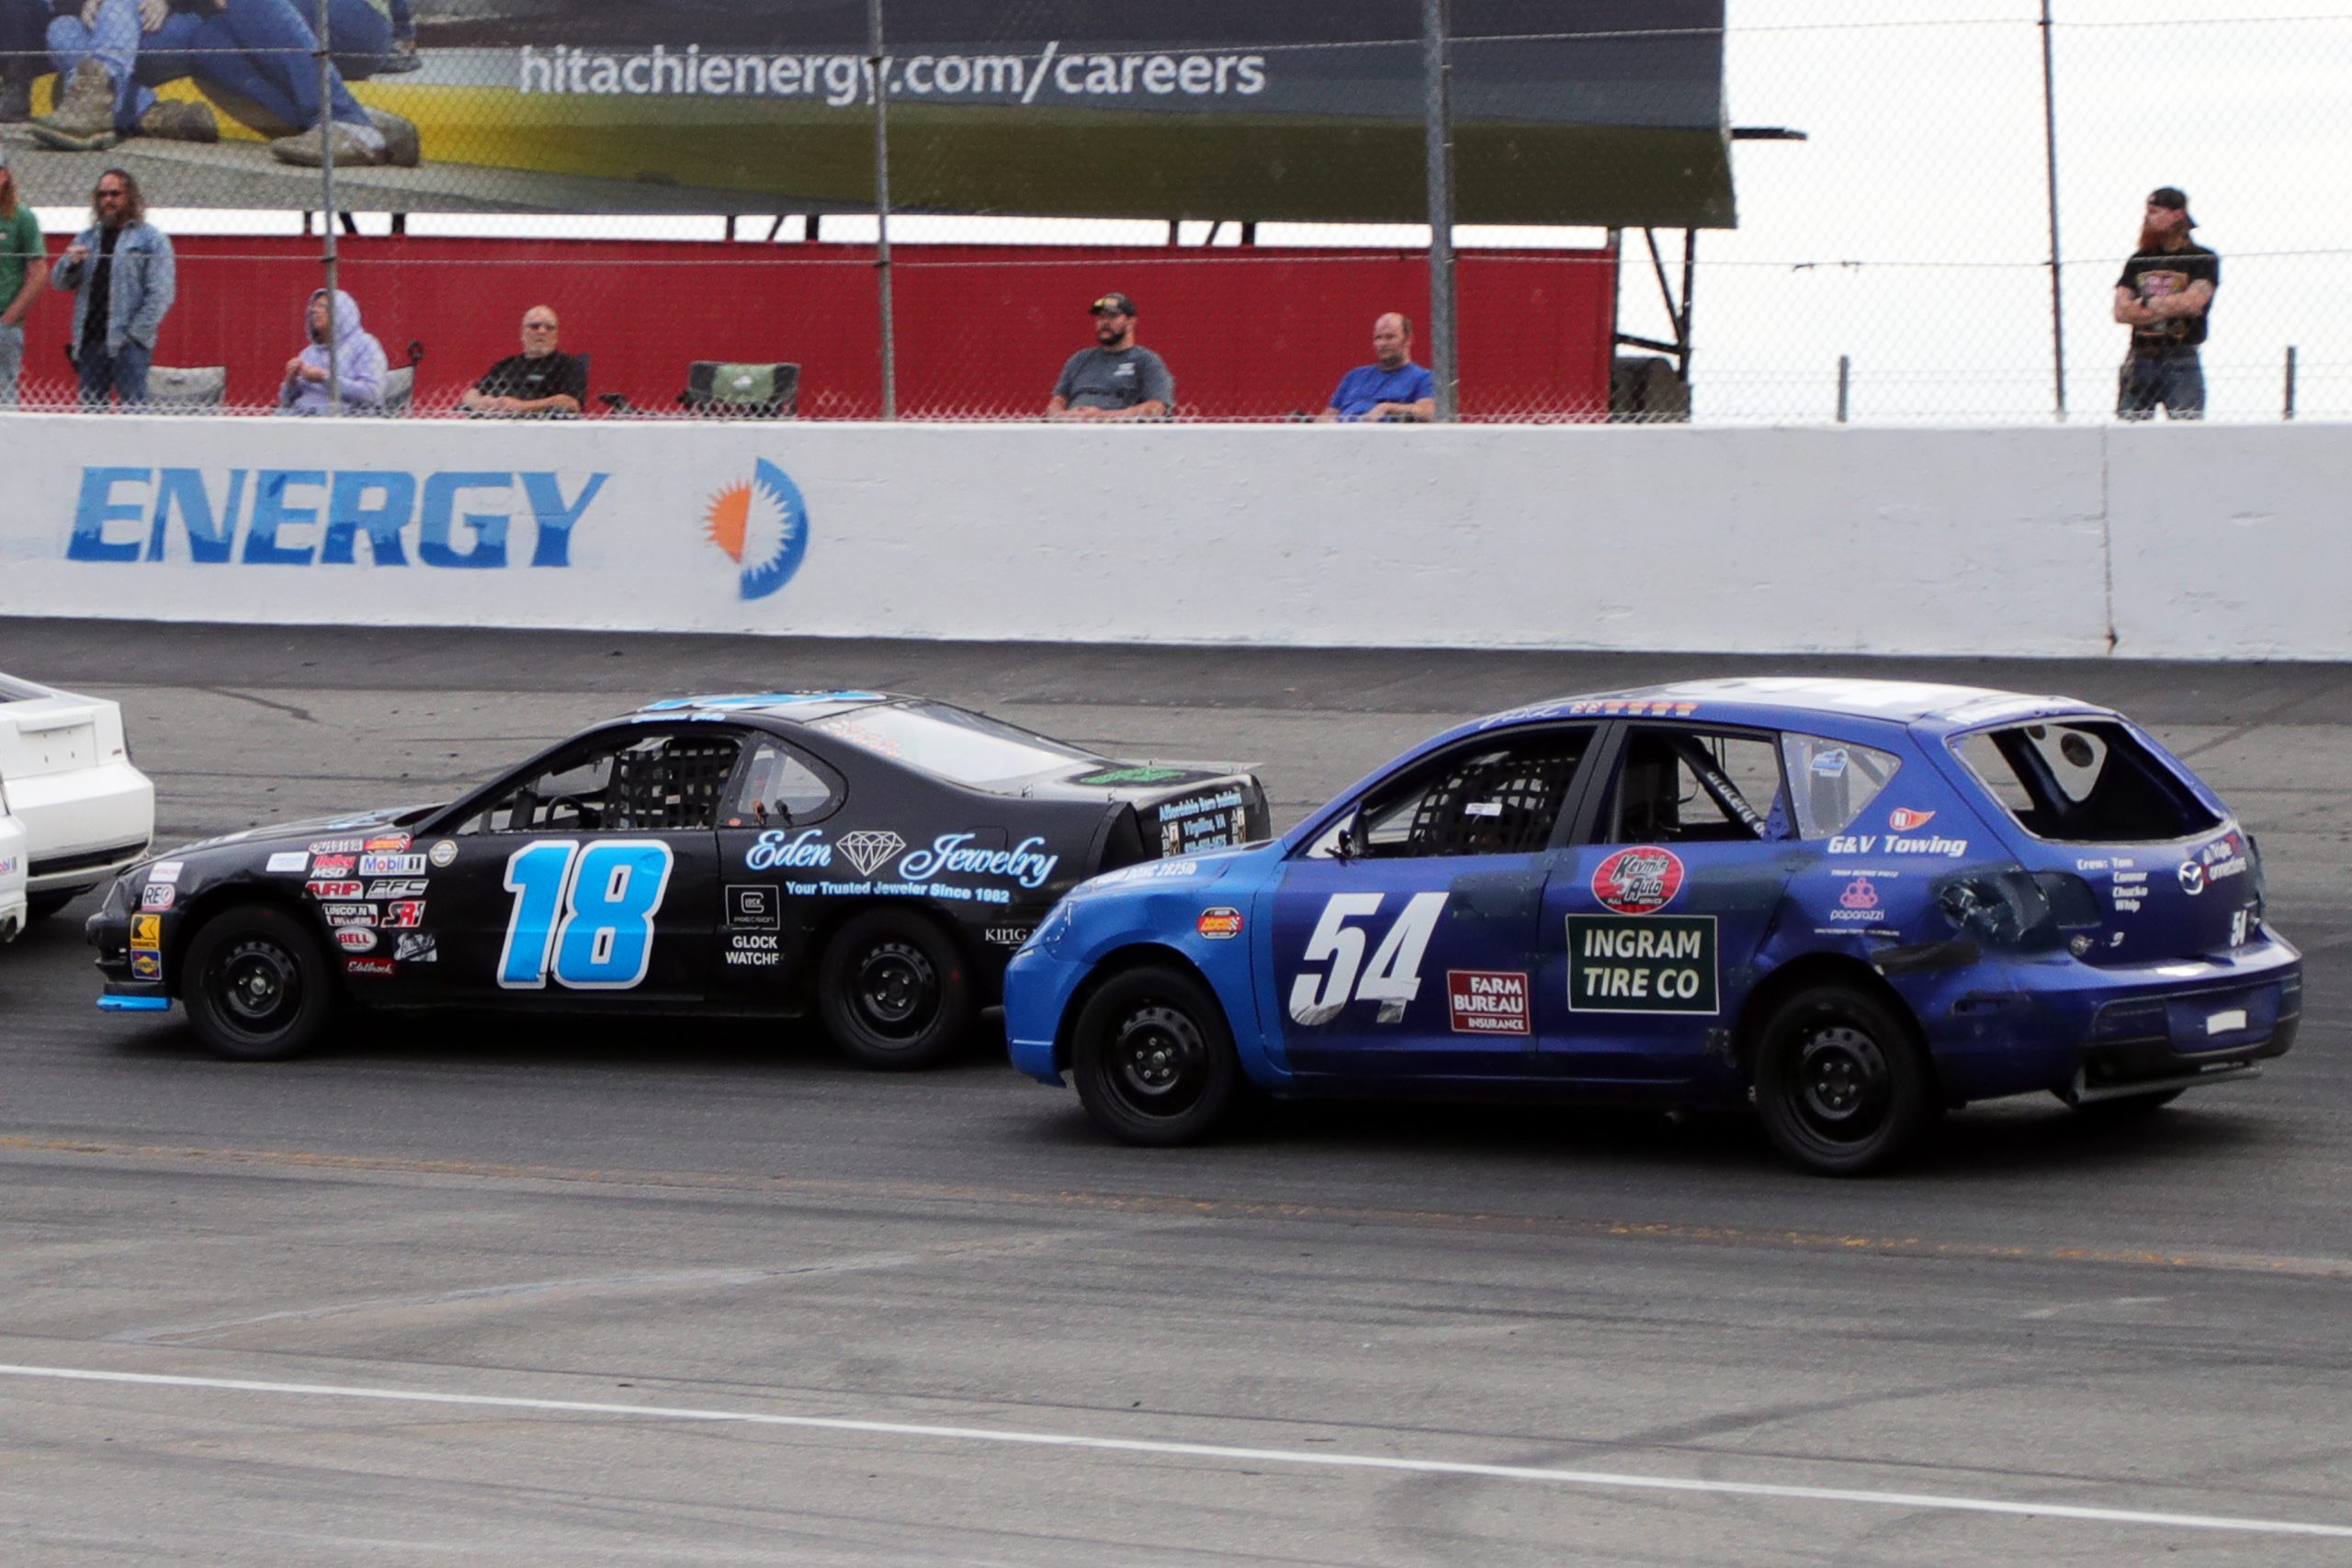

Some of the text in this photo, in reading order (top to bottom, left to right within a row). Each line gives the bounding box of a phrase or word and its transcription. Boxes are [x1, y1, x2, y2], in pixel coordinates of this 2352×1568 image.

[517, 40, 1267, 107] hitachienergy.com/careers
[66, 466, 611, 568] ENERGY
[1827, 835, 1968, 858] G&V Towing
[365, 856, 423, 871] Mobil 1
[745, 829, 1058, 888] Eden Jewelry
[307, 883, 361, 897] ARP
[786, 882, 1010, 903] Your Trusted Jeweler Since 1982
[1623, 875, 1664, 902] Auto
[324, 907, 368, 916] LINCOLN
[497, 840, 673, 989] 18
[1830, 909, 1884, 921] paparazzi
[338, 933, 370, 944] BELL
[732, 936, 778, 949] GLOCK
[985, 928, 1027, 942] KING
[1583, 929, 1701, 959] INGRAM
[725, 952, 785, 965] WATCHE
[1289, 892, 1449, 1025] 54
[1471, 977, 1522, 995] FARM
[1583, 967, 1699, 998] TIRE CO
[1453, 995, 1523, 1012] BUREAU
[1468, 1017, 1524, 1030] INSURANCE
